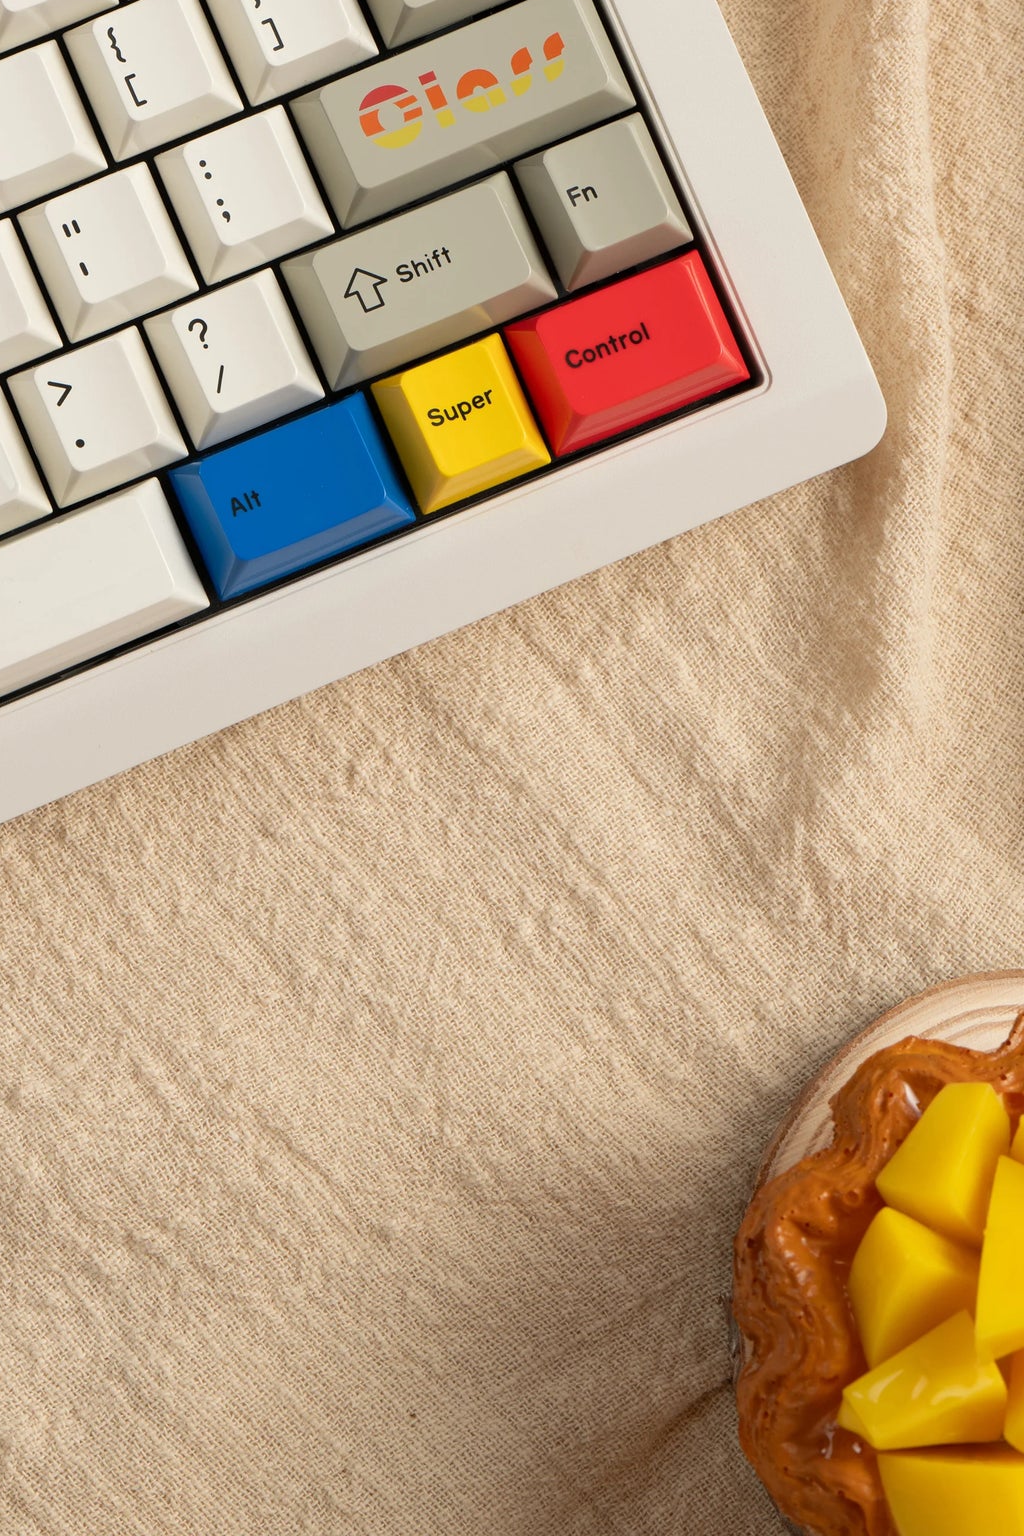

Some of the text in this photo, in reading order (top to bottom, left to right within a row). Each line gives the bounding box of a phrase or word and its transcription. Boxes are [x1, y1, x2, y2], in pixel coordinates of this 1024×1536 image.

[108, 27, 126, 62] {
[261, 18, 284, 51] ]
[125, 74, 147, 107] [
[199, 160, 212, 179] :
[217, 199, 230, 222] ;
[566, 184, 598, 207] Fn
[396, 247, 451, 282] Shift
[188, 319, 208, 349] ?
[565, 322, 650, 368] Control
[47, 381, 72, 406] >
[217, 365, 224, 393] /
[428, 390, 492, 426] Super
[231, 491, 261, 517] Alt
